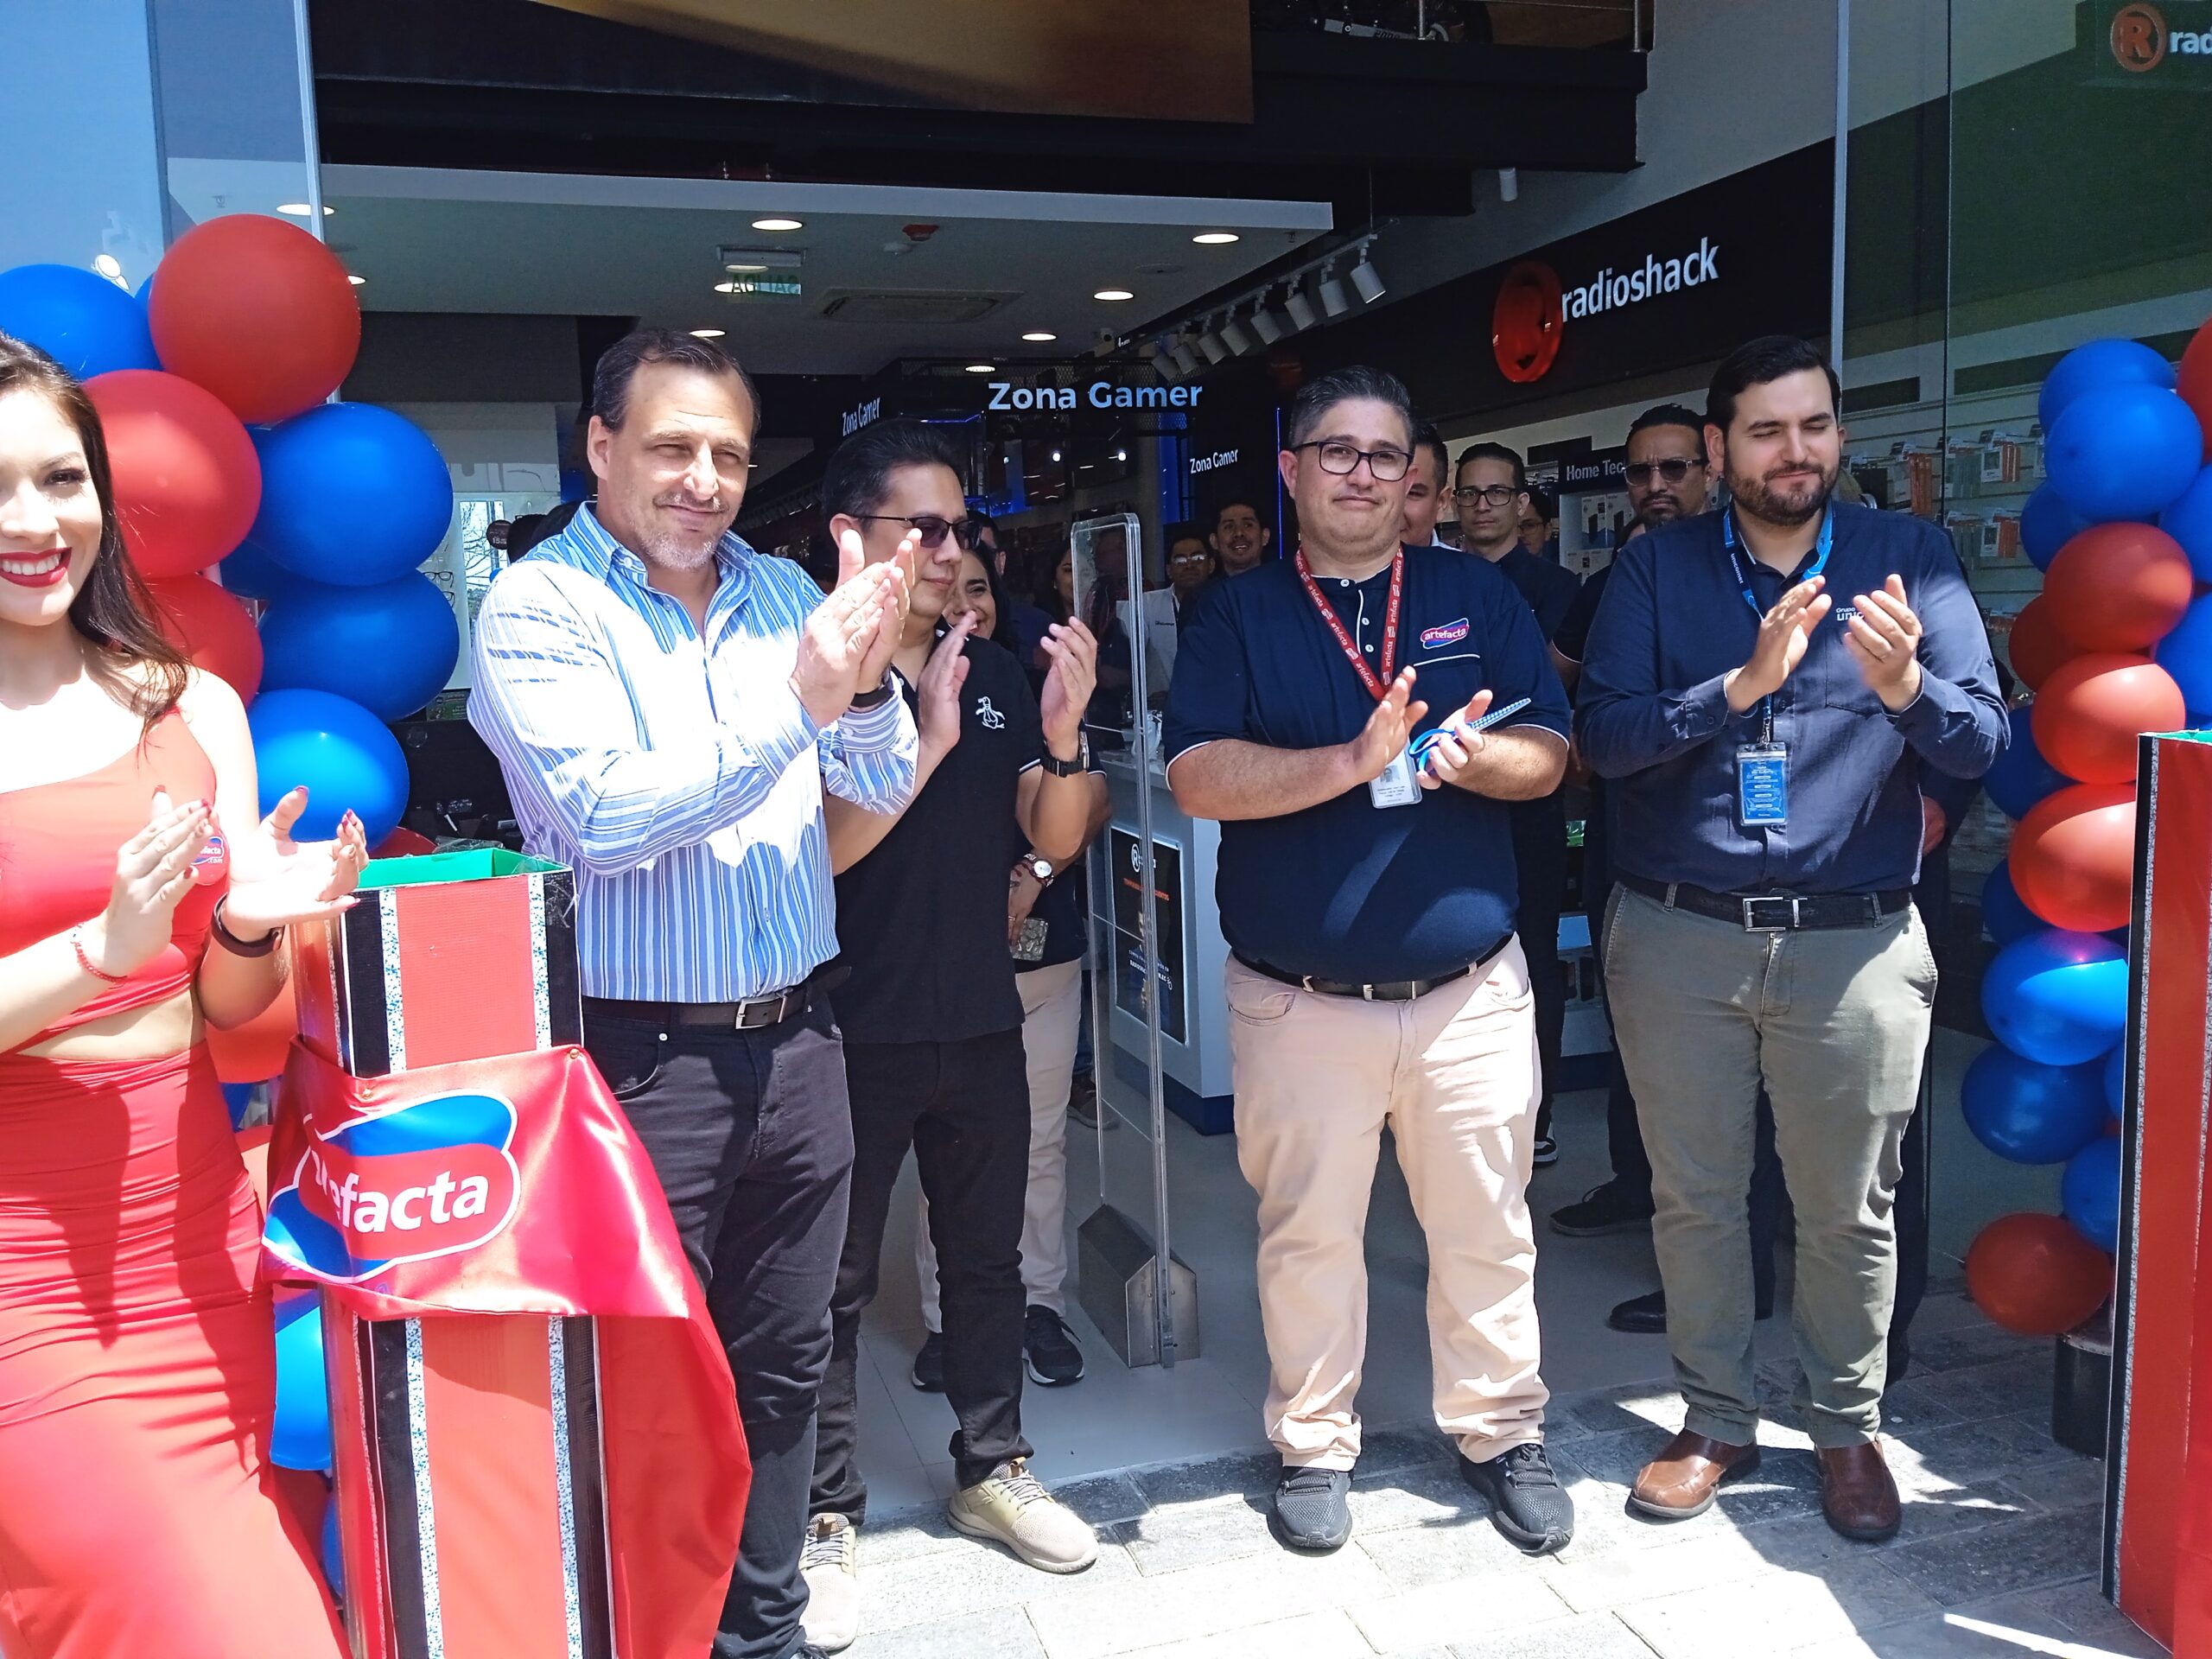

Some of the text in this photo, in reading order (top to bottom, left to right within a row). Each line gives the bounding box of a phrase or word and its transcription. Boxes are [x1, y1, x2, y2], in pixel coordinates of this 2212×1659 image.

[1561, 237, 1719, 323] radioshack
[988, 381, 1203, 410] Zona Gamer
[842, 397, 880, 436] Zona Gamer
[1190, 449, 1239, 474] Zona Gamer
[1566, 464, 1599, 482] Home
[1331, 622, 1348, 646] artefacta
[1424, 627, 1466, 640] artefacta
[1356, 662, 1374, 688] artefacta
